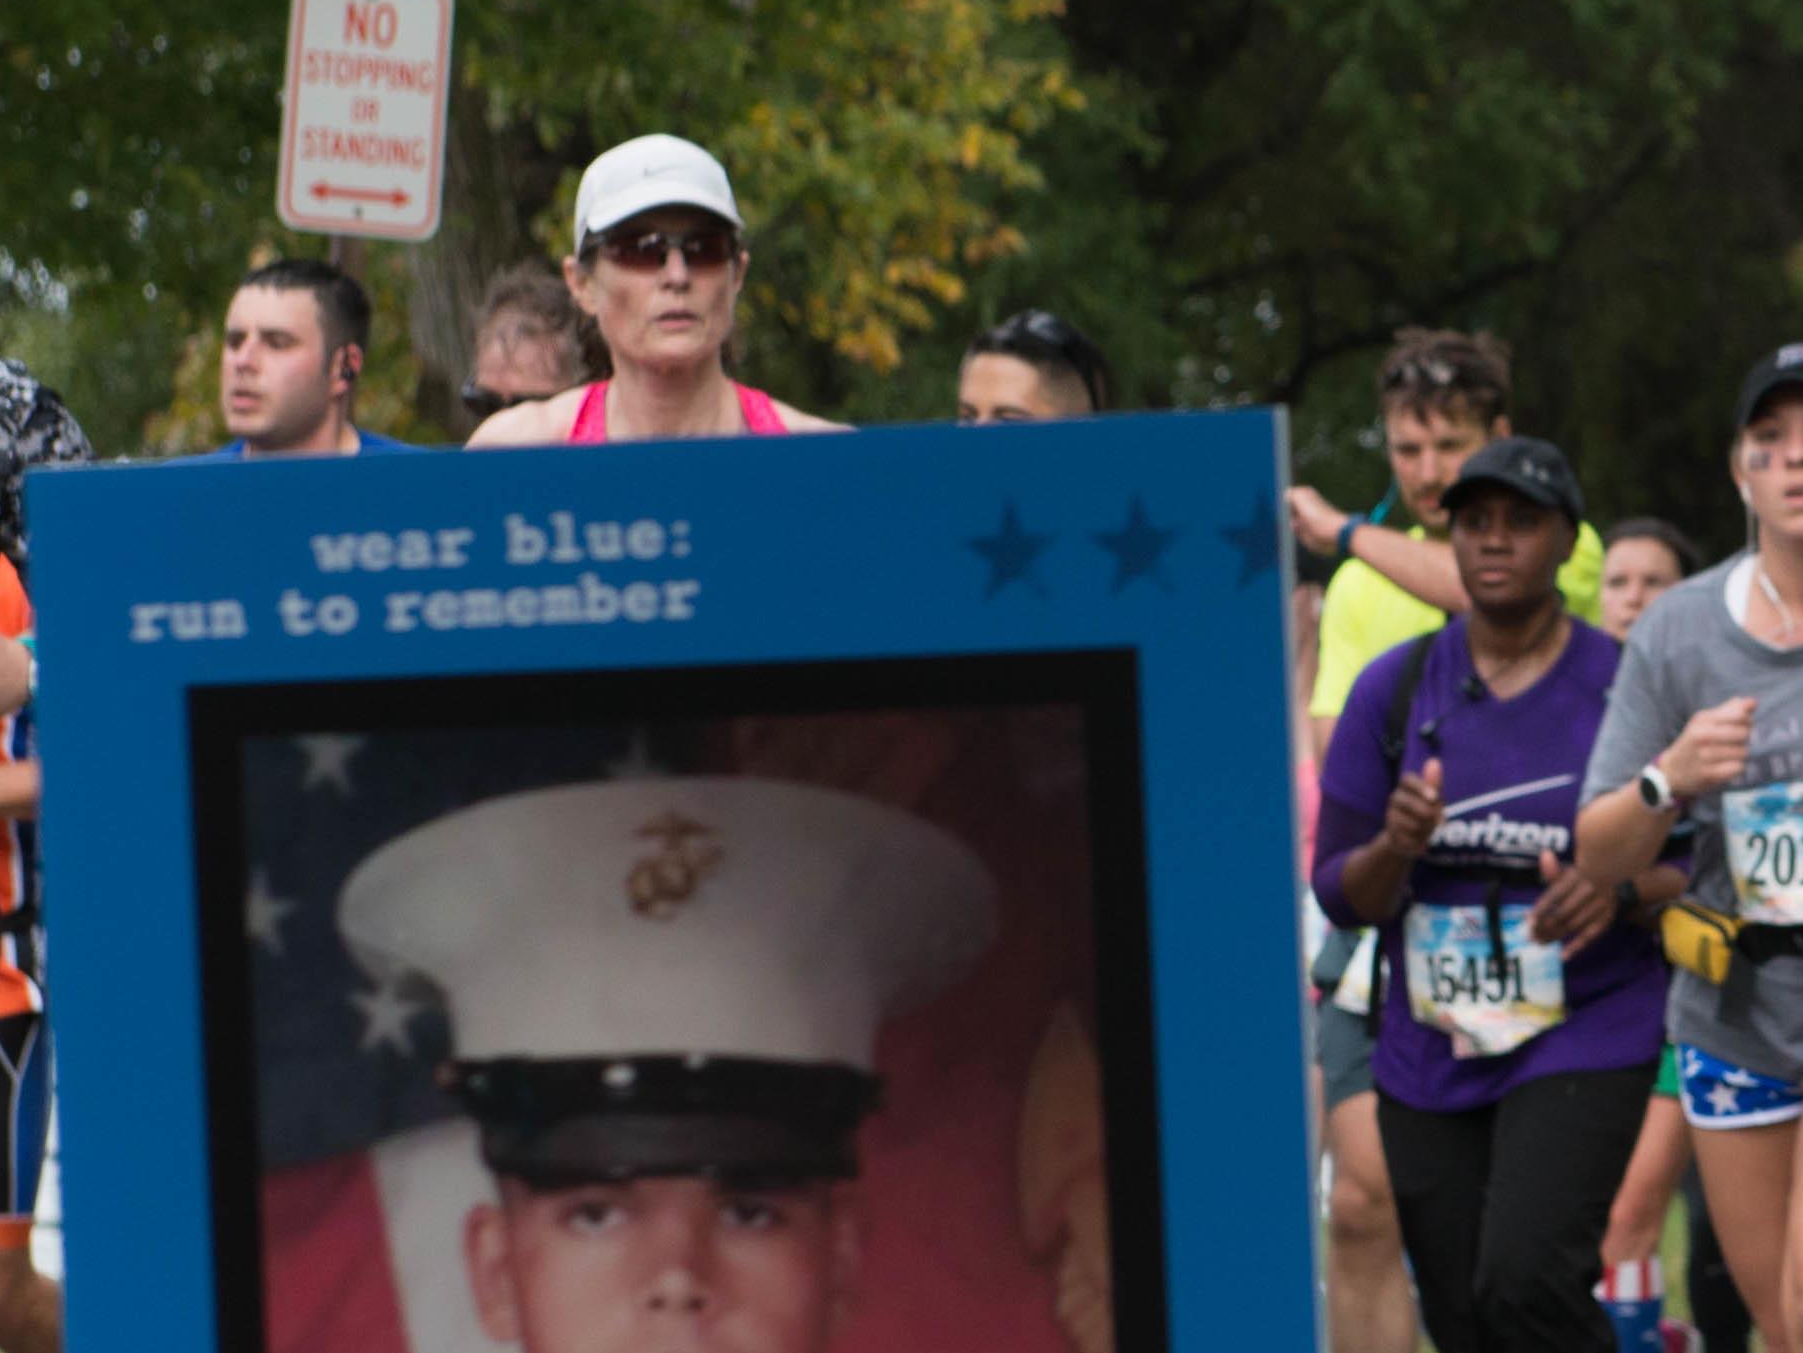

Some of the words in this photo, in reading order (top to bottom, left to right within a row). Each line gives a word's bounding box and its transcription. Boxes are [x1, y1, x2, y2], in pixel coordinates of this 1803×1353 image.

[344, 1, 398, 51] NO
[303, 51, 434, 96] STOPPING
[351, 98, 380, 124] OR
[301, 126, 426, 173] STANDING
[309, 527, 475, 573] wear
[504, 512, 693, 566] blue:
[130, 598, 248, 643] run
[278, 588, 359, 636] to
[383, 574, 700, 633] remember
